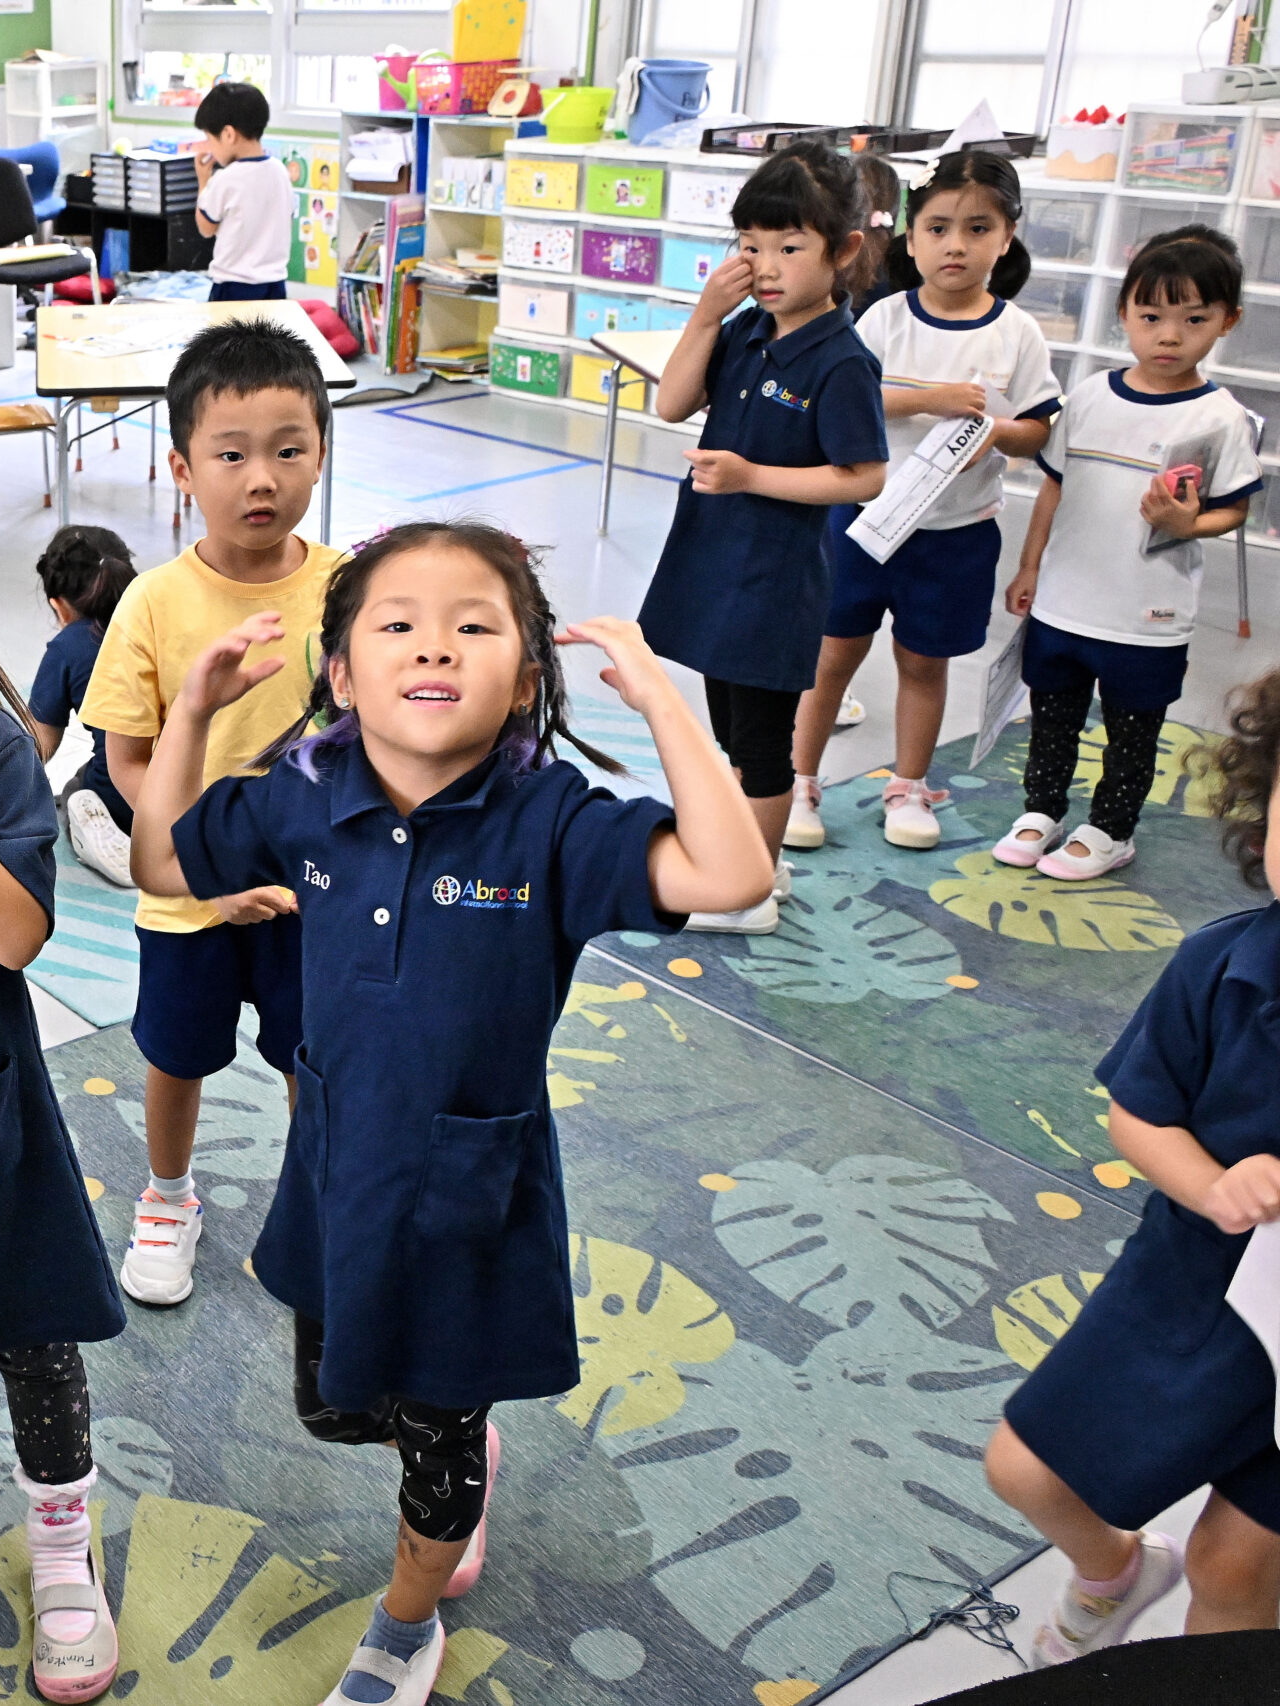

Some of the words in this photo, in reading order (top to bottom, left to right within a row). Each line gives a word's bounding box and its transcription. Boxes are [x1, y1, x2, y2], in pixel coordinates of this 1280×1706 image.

[774, 386, 811, 408] Abroad
[303, 860, 331, 890] Tao
[461, 878, 530, 902] Abroad
